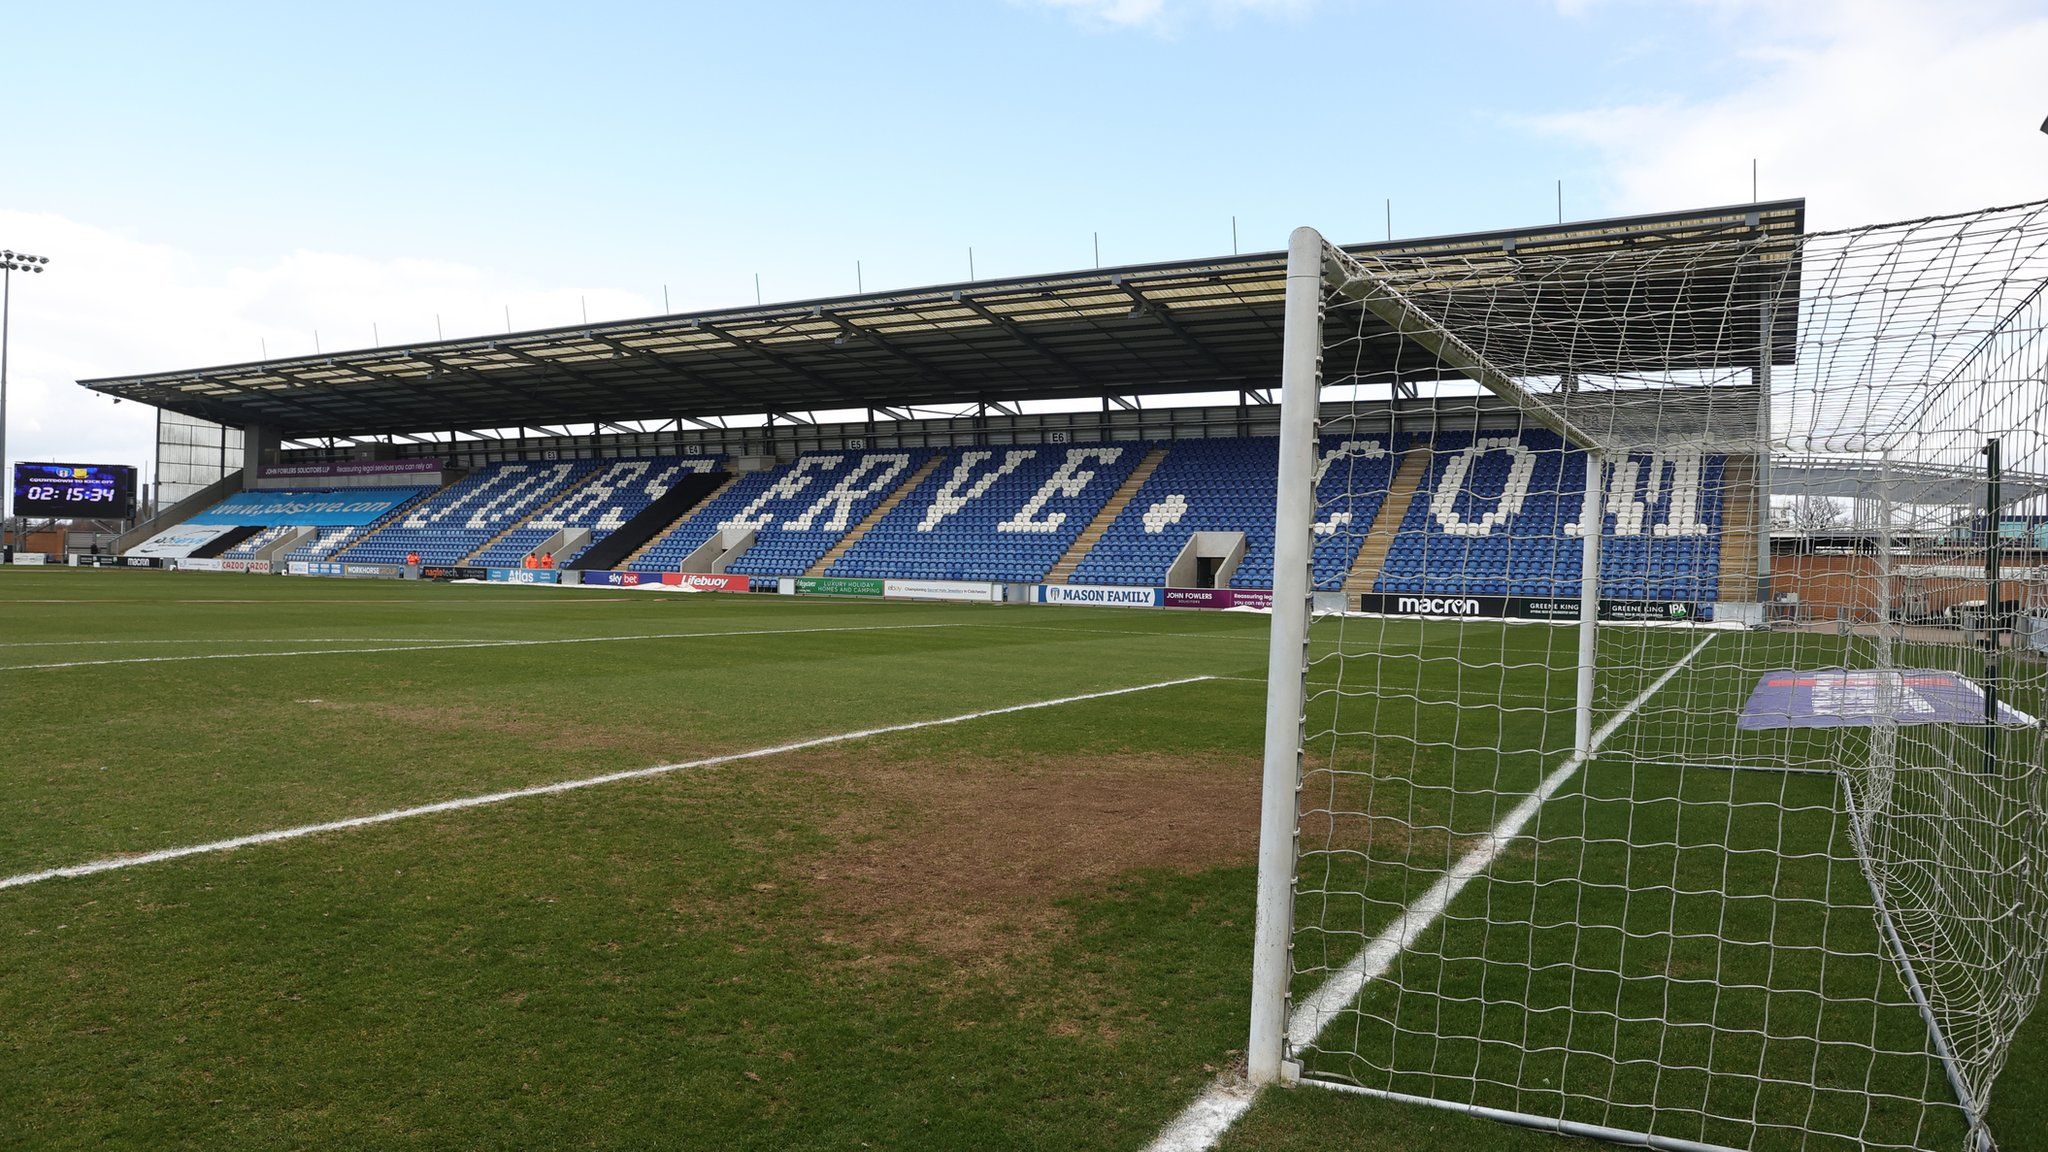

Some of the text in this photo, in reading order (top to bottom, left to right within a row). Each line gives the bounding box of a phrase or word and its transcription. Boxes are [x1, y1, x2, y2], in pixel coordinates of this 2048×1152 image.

[1052, 433, 1064, 442] E6
[851, 440, 861, 449] E5
[297, 466, 321, 474] SOLICITORS
[336, 465, 361, 474] Reassuring
[362, 465, 375, 474] legal
[375, 464, 394, 472] services
[395, 464, 404, 472] you
[416, 463, 425, 471] rely
[222, 560, 245, 571] CAZOO
[508, 569, 534, 582] Atlas
[608, 573, 639, 585] sky bet
[681, 574, 729, 588] Lifebuoy
[1063, 589, 1150, 603] MASON FAMILY
[1166, 592, 1213, 600] JOHN FOWLERS
[1233, 593, 1273, 602] Reassuring leg
[1399, 597, 1480, 615] macron
[1529, 602, 1579, 611] GREENE KING
[1611, 604, 1642, 612] GREENE
[1669, 602, 1687, 615] IPA
